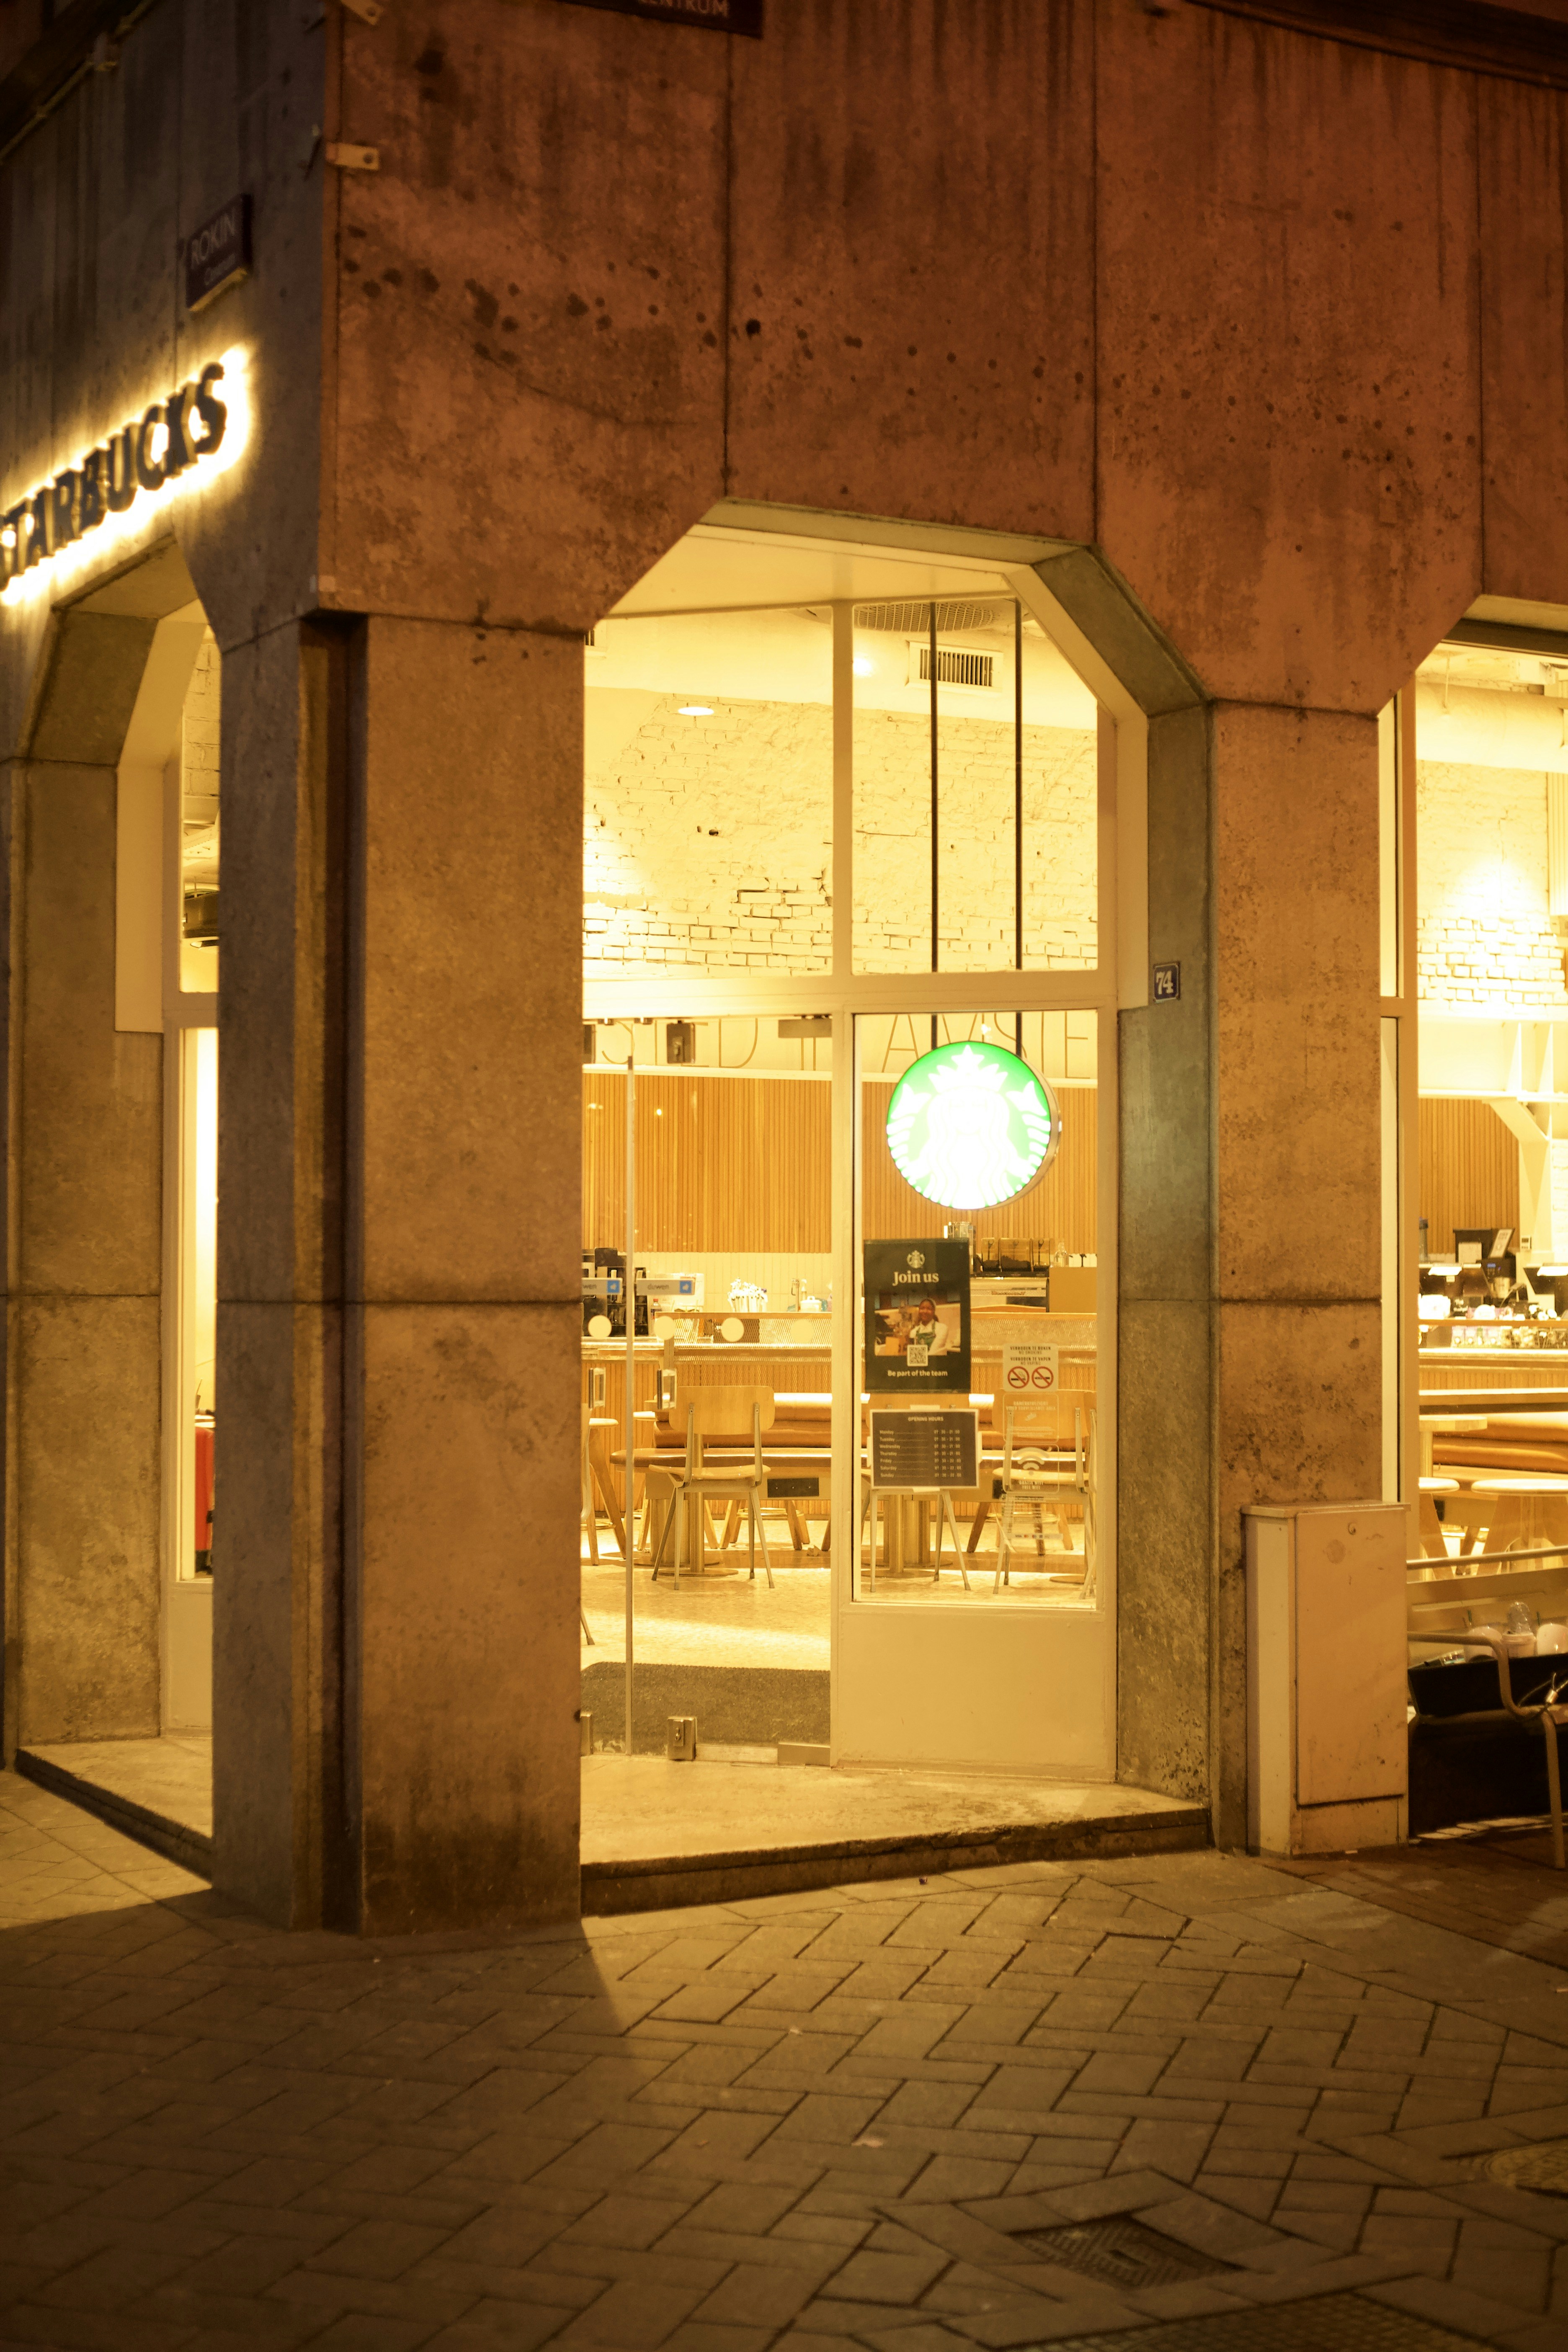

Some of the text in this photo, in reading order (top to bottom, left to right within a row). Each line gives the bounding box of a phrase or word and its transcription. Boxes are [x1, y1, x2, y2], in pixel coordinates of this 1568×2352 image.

[0, 362, 227, 591] TARBUCKS
[1156, 970, 1174, 995] 74
[892, 1270, 939, 1287] Join us
